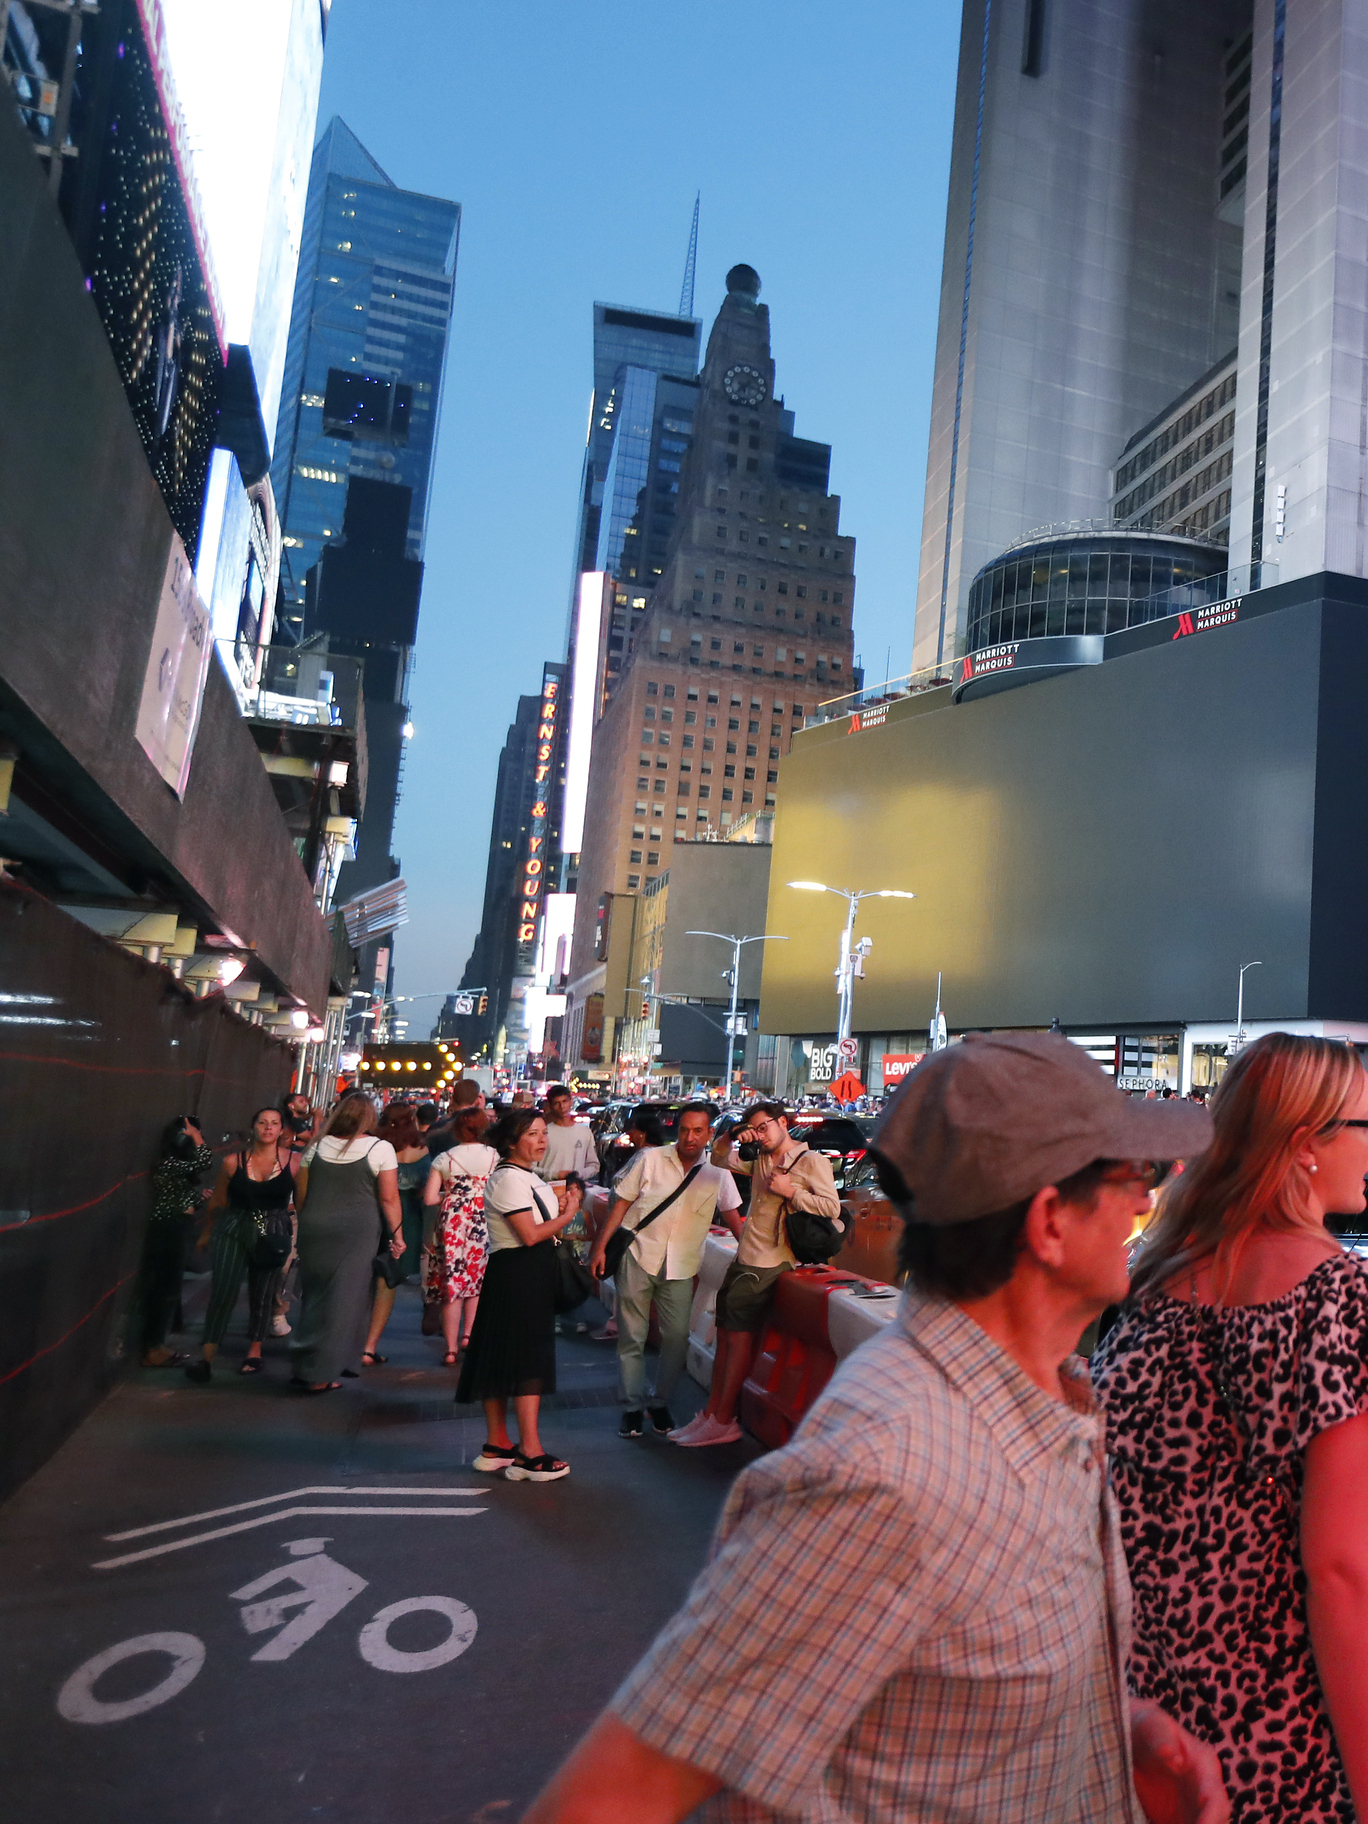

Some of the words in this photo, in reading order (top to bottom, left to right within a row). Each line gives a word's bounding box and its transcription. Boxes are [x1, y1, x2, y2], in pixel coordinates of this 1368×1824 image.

[1198, 598, 1243, 619] MARRIOTT
[1197, 611, 1237, 630] MARQUIS
[975, 644, 1020, 662] MARRIOTT
[975, 656, 1013, 674] MARQUIS
[862, 715, 886, 728] MARQUIS
[863, 706, 890, 719] MARRIOTT
[536, 681, 559, 782] ERNST
[531, 801, 547, 818] &
[518, 836, 543, 942] YOUNG
[811, 1047, 833, 1067] BIG
[810, 1067, 832, 1080] BOLD
[1119, 1078, 1168, 1090] SEPHORA
